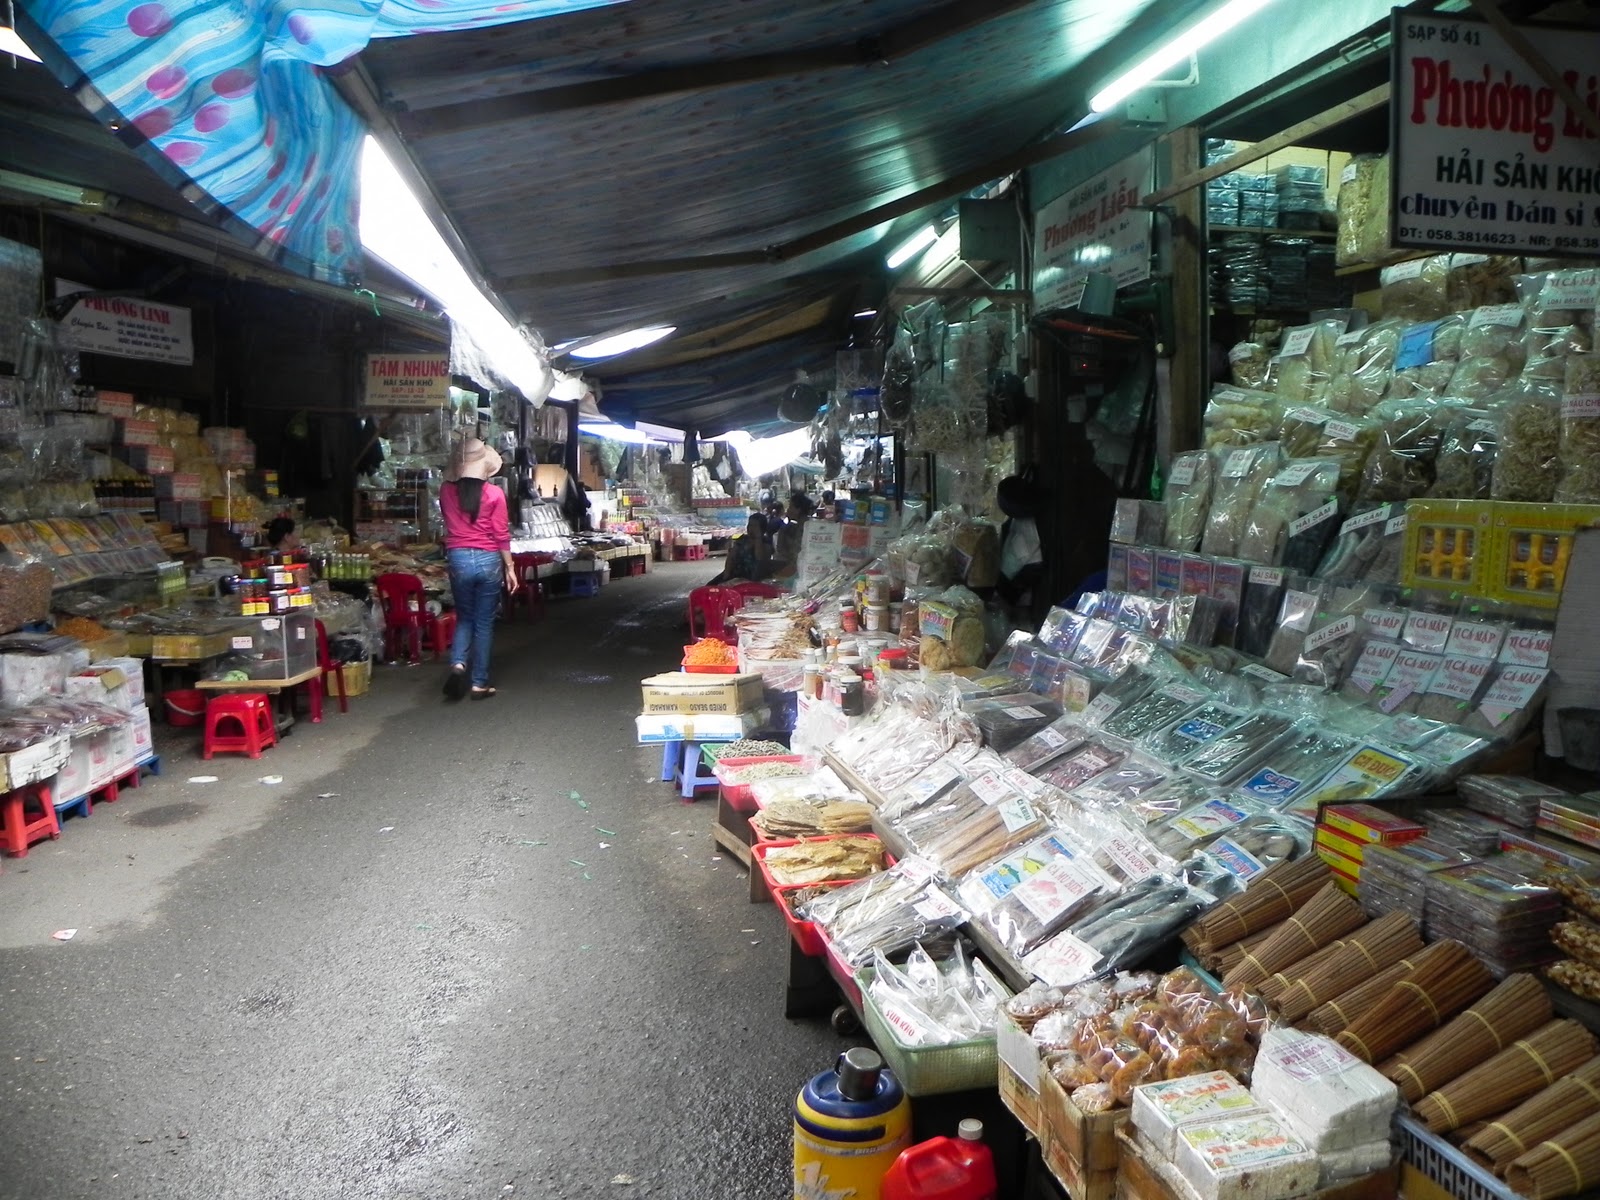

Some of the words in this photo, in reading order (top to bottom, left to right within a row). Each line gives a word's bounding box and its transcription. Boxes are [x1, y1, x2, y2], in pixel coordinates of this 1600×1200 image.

[1408, 24, 1436, 43] SẠP
[1441, 24, 1459, 43] SỐ
[1464, 31, 1481, 46] 41
[1411, 57, 1555, 153] Phương
[1436, 148, 1484, 185] HẢI
[1493, 152, 1547, 190] SẢN
[1506, 200, 1556, 225] bán
[1427, 228, 1516, 245] 058.3814623
[403, 360, 449, 377] NHUNG
[649, 703, 679, 712] KAWAHAGI
[709, 703, 728, 712] DRIED
